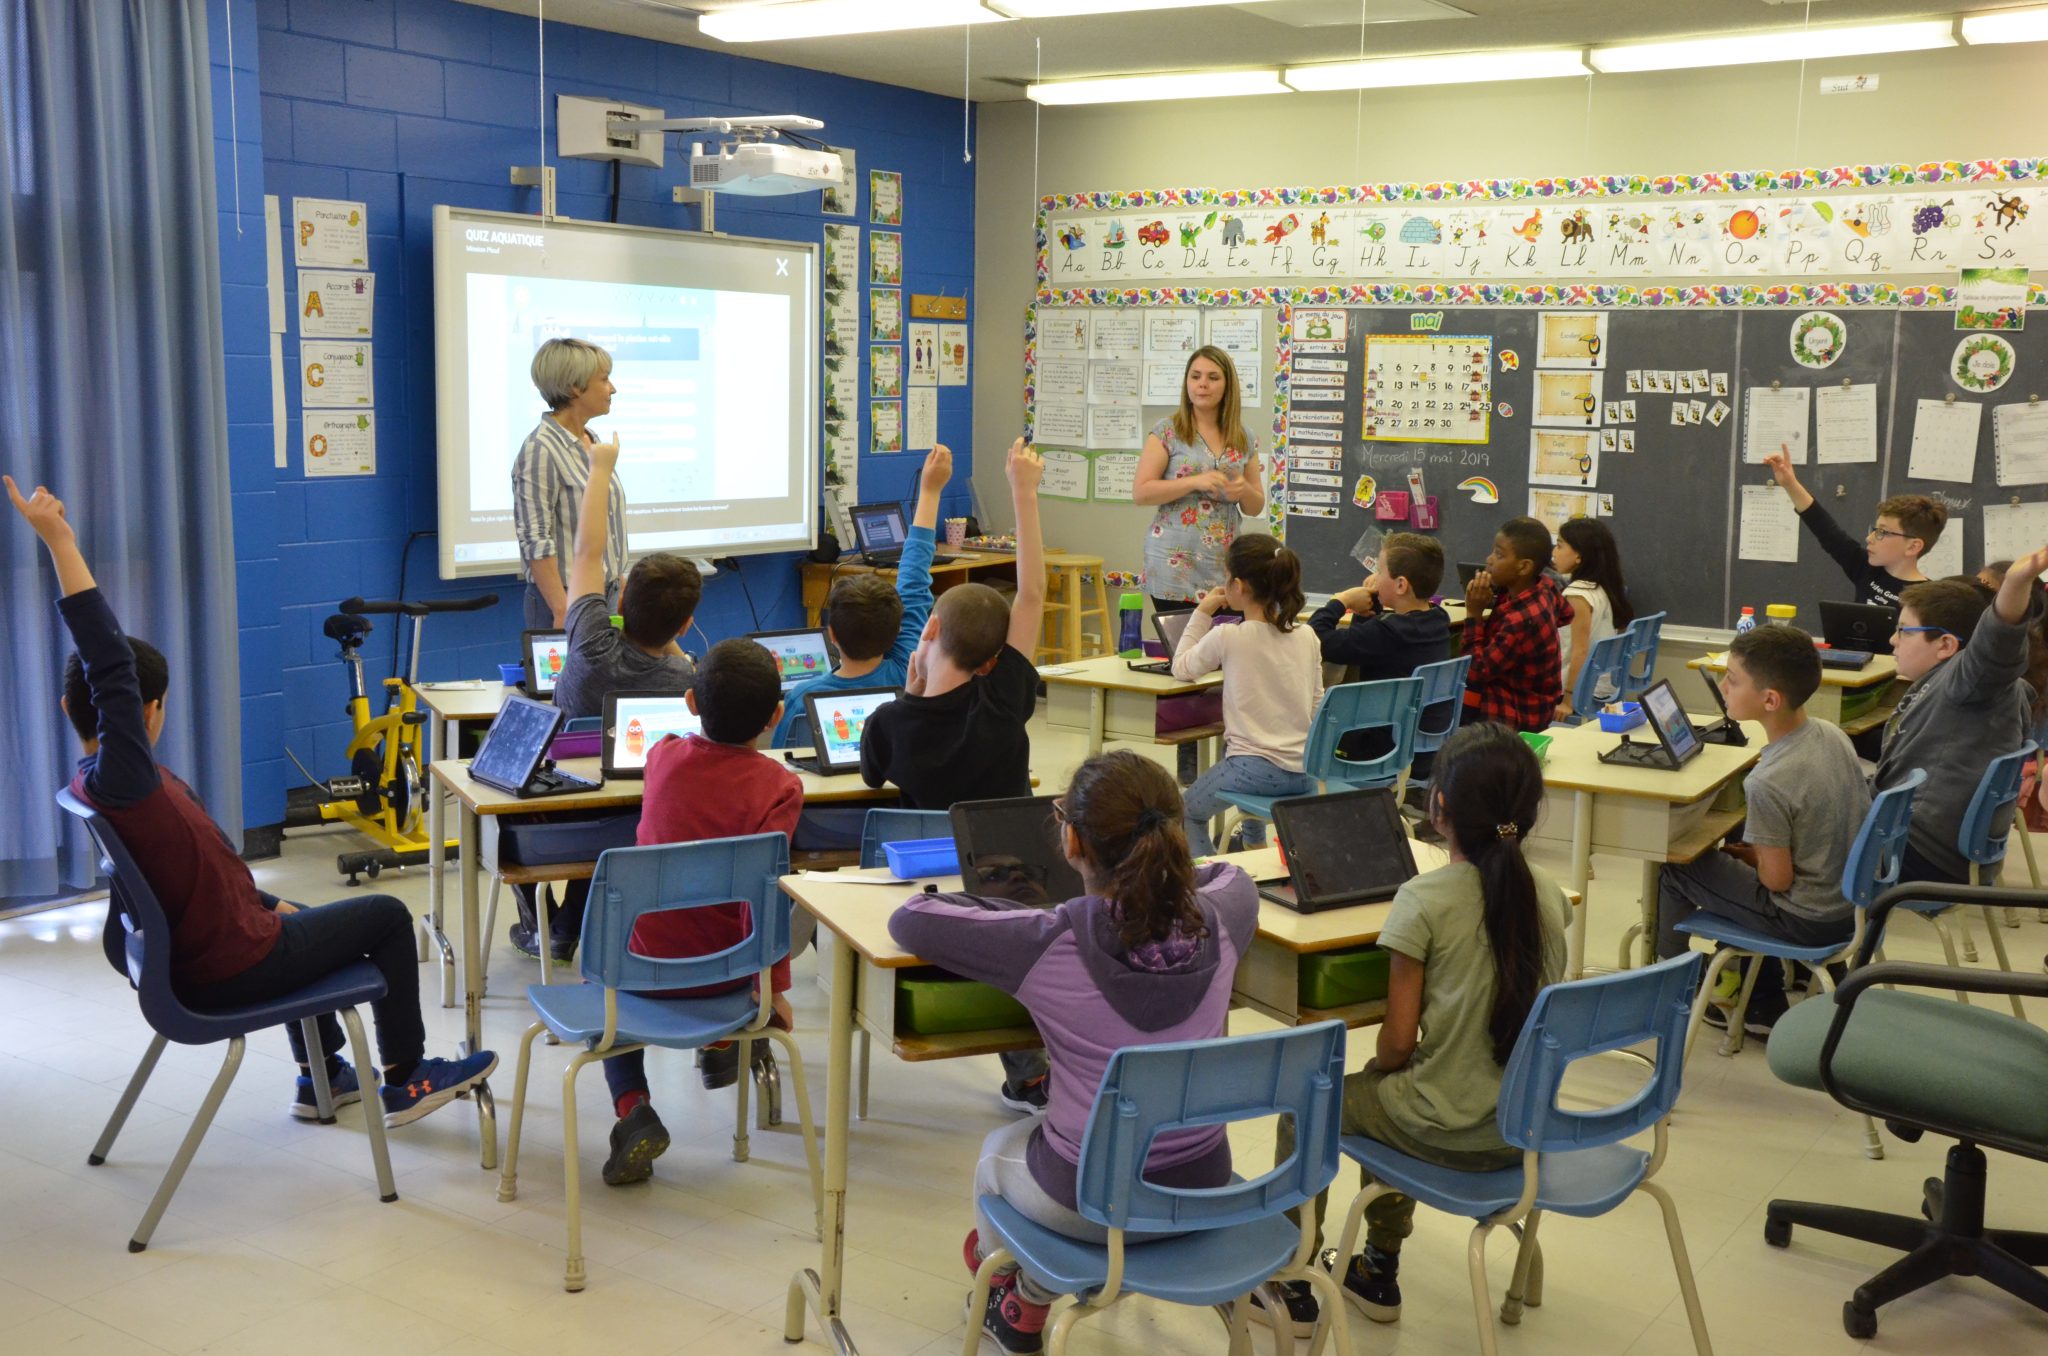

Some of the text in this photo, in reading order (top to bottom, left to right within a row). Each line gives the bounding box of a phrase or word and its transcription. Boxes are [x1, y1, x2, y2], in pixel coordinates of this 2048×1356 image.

[1831, 80, 1849, 93] Sud
[300, 220, 315, 247] P
[465, 228, 544, 248] QUIZ AQUATIQUE
[304, 291, 324, 318] A
[1412, 313, 1442, 329] mai
[1808, 335, 1829, 348] Urgent
[1448, 364, 1453, 372] 9
[1463, 364, 1471, 372] 10
[1972, 359, 1996, 369] Je dois
[306, 363, 325, 388] C
[1377, 381, 1383, 389] 12
[1445, 382, 1453, 390] 16
[1462, 383, 1470, 391] 17
[1376, 400, 1383, 408] 19
[1391, 400, 1402, 408] 20
[1443, 403, 1453, 411] 23
[1374, 417, 1384, 425] 26
[1408, 419, 1418, 427] 28
[1424, 419, 1435, 427] 29
[1440, 420, 1451, 428] 30
[309, 433, 328, 458] O
[1362, 444, 1490, 467] Mercredi 15 mai 2019
